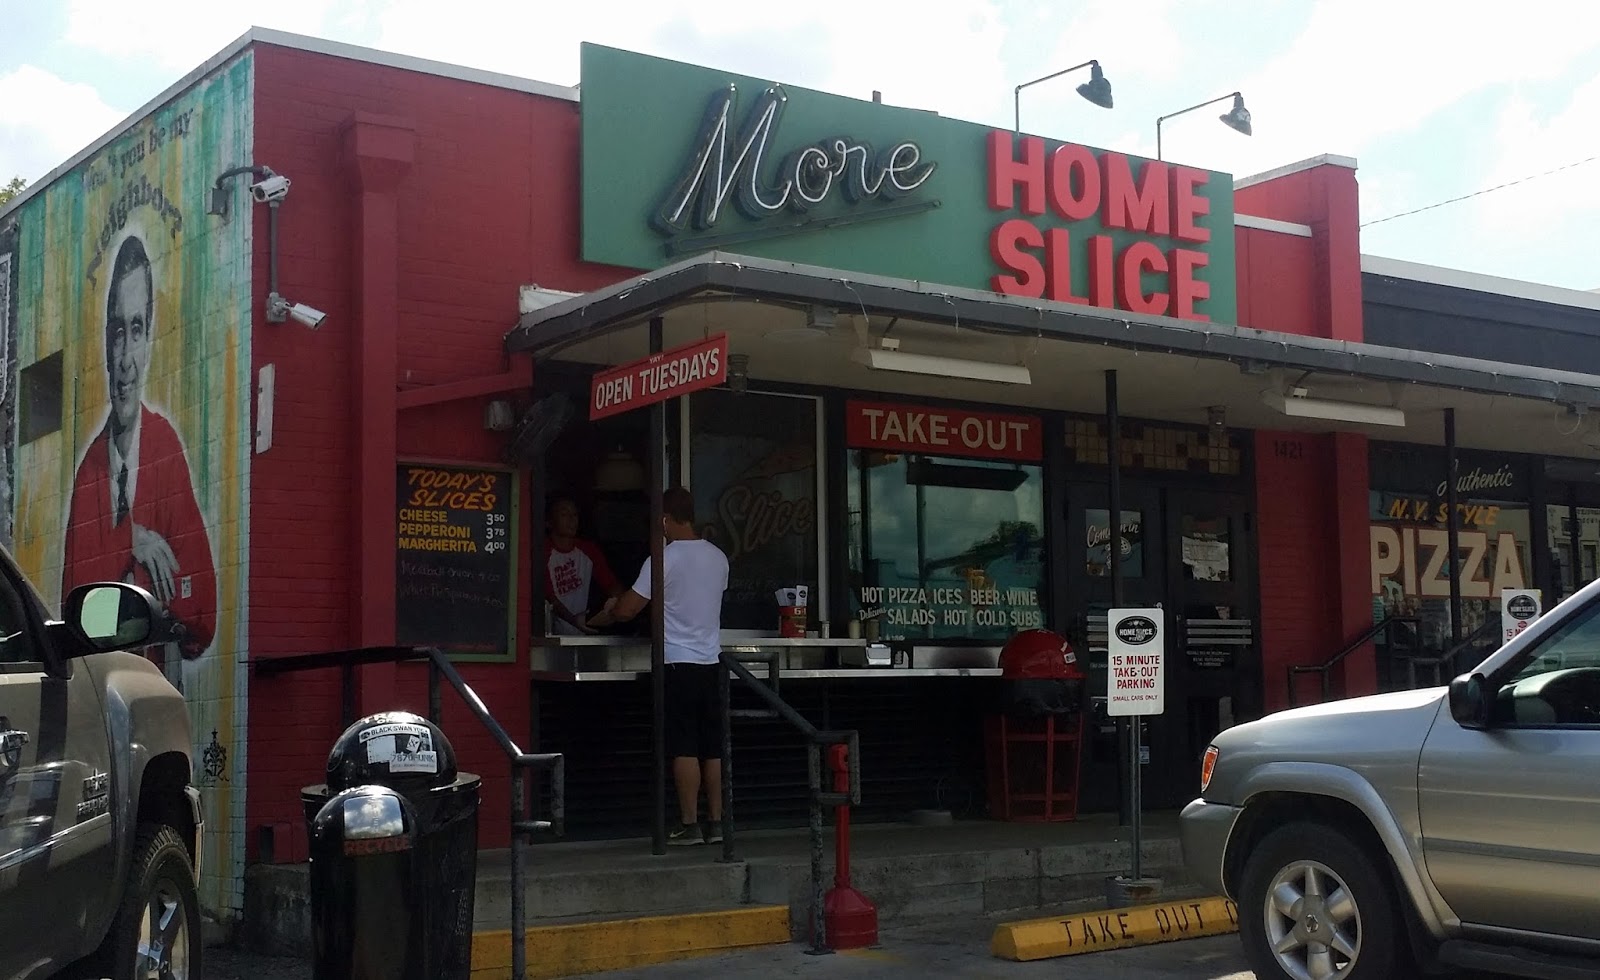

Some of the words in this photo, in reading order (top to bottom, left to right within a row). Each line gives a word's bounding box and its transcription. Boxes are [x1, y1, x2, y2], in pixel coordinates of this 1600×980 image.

[651, 83, 938, 233] More
[986, 129, 1210, 243] HOME
[989, 219, 1210, 322] SLICE
[649, 354, 664, 363] YAY!
[595, 374, 633, 410] OPEN
[639, 347, 720, 396] TUESDAYS
[862, 408, 1029, 451] TAKE-OUT
[408, 469, 497, 493] TODAY'S
[409, 489, 497, 512] SLICES
[1389, 499, 1427, 521] N.Y.
[399, 508, 448, 522] CHEESE
[399, 522, 471, 538] PEPPERONI
[1087, 525, 1111, 548] Com
[399, 538, 477, 553] MARGHERITA
[1369, 525, 1526, 597] PIZZA
[861, 587, 884, 604] HOT
[888, 587, 927, 604] PIZZA
[933, 588, 963, 605] ICES
[970, 589, 1000, 606] BEER
[1007, 590, 1038, 606] WINE
[887, 608, 936, 625] SALADS
[944, 609, 968, 626] HOT
[976, 609, 1007, 626] COLD
[1010, 611, 1041, 627] SUBS
[1119, 628, 1135, 636] HOME
[1506, 629, 1513, 637] 15
[1112, 656, 1122, 666] 15
[1126, 655, 1160, 665] MINUTE
[1113, 667, 1159, 678] TAKE-OUT
[1117, 679, 1155, 689] PARKING
[371, 727, 393, 736] BLACK
[1060, 912, 1134, 947] TAKE
[1155, 903, 1204, 935] OUT
